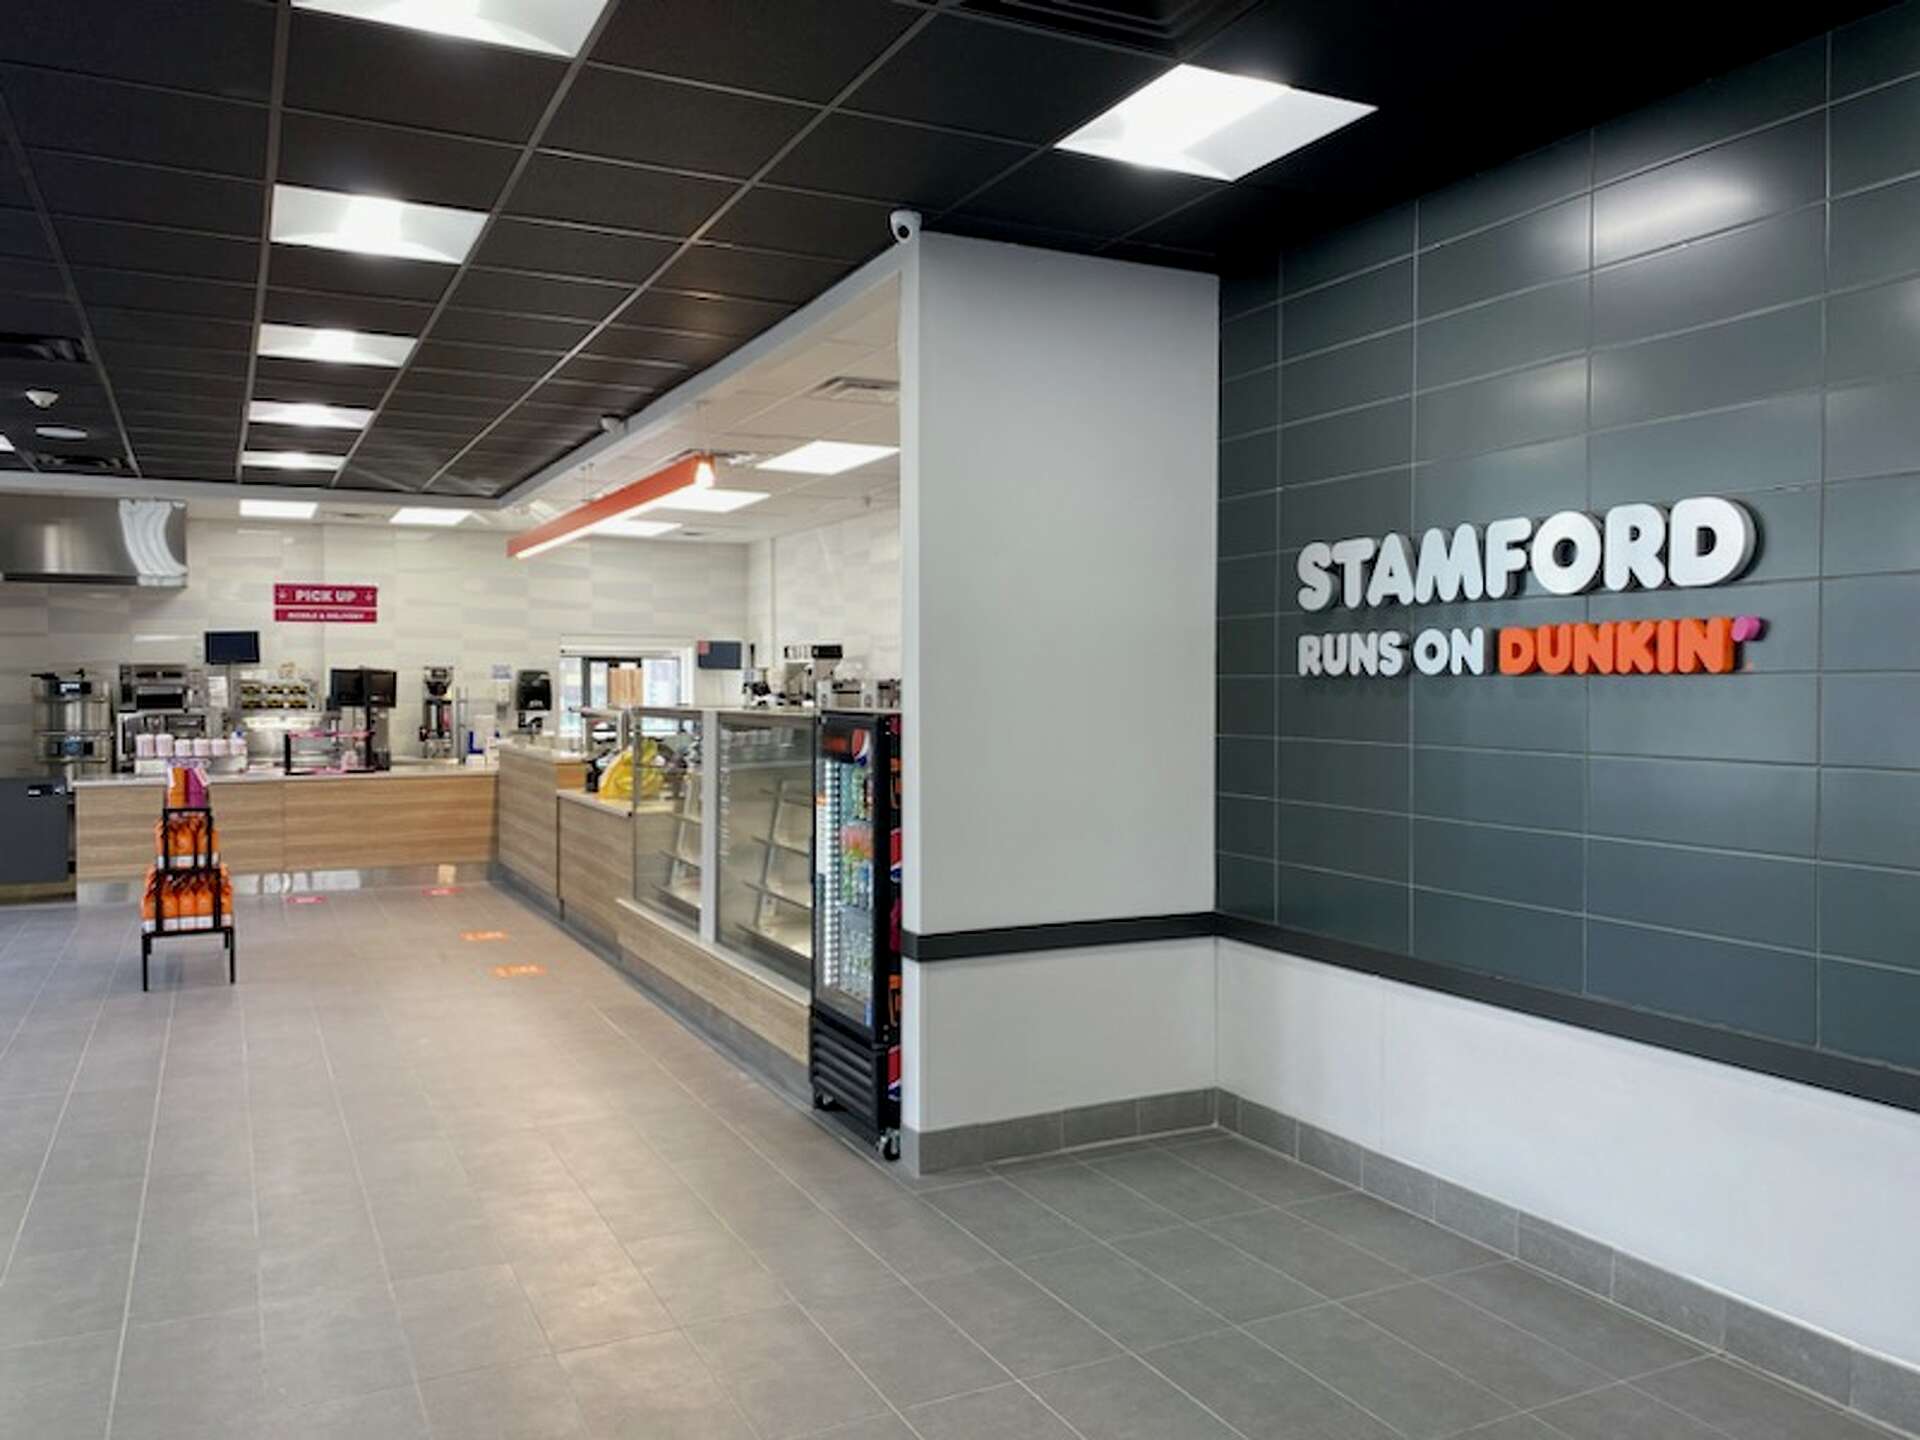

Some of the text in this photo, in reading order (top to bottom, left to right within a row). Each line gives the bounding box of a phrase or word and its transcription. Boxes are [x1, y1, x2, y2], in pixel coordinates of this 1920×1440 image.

[1298, 496, 1752, 612] STAMFORD
[295, 590, 357, 603] PICK UP
[1298, 616, 1761, 677] RUNS ON DUNKIN'
